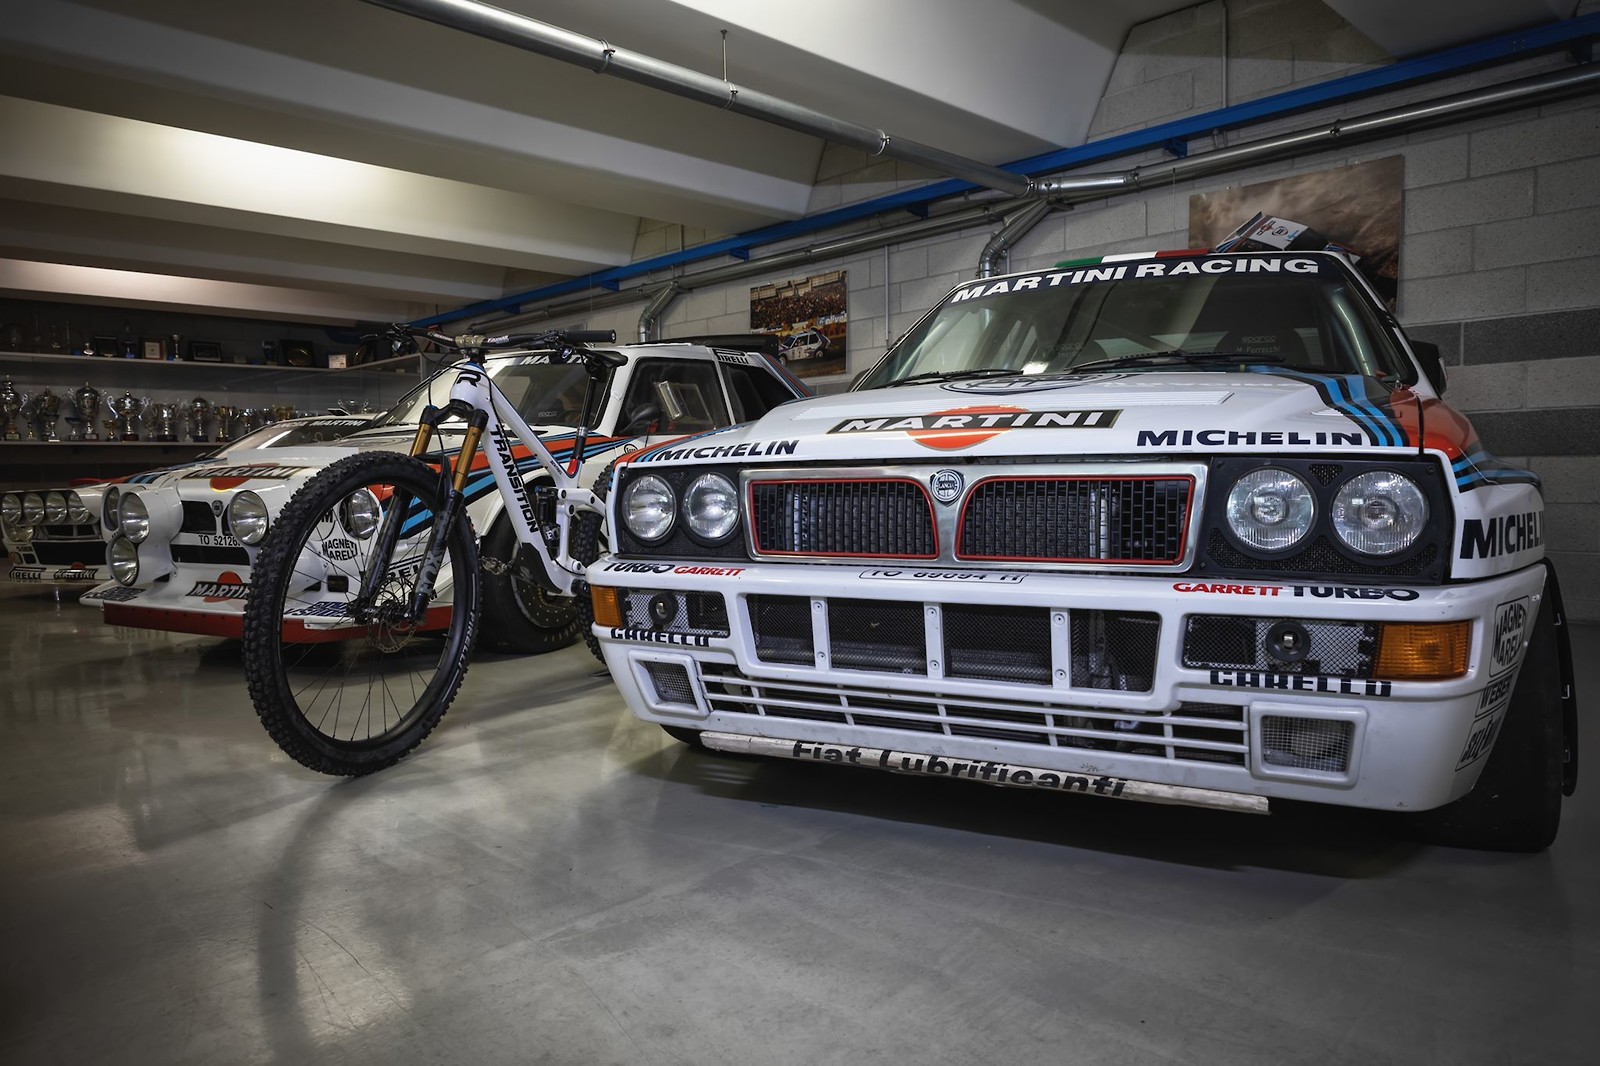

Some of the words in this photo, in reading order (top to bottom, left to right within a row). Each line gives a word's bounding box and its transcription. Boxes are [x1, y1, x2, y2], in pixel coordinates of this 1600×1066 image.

[951, 265, 1128, 303] MARTINI
[1136, 257, 1319, 278] RACING
[838, 411, 1104, 432] MARTINI
[1137, 429, 1363, 446] MICHELIN
[655, 440, 800, 462] MICHELIN
[189, 467, 304, 478] MARTINI
[490, 423, 539, 533] TRANSITION
[199, 534, 210, 545] TO
[322, 538, 358, 550] MAGNETI
[604, 562, 675, 574] TURBO
[674, 566, 745, 576] GARRETT
[1173, 582, 1283, 596] GARRETT
[1289, 585, 1420, 602] TURBO
[458, 611, 476, 668] PIRELLI
[793, 739, 862, 765] Fiat
[879, 750, 1127, 797] Lubrificanti
